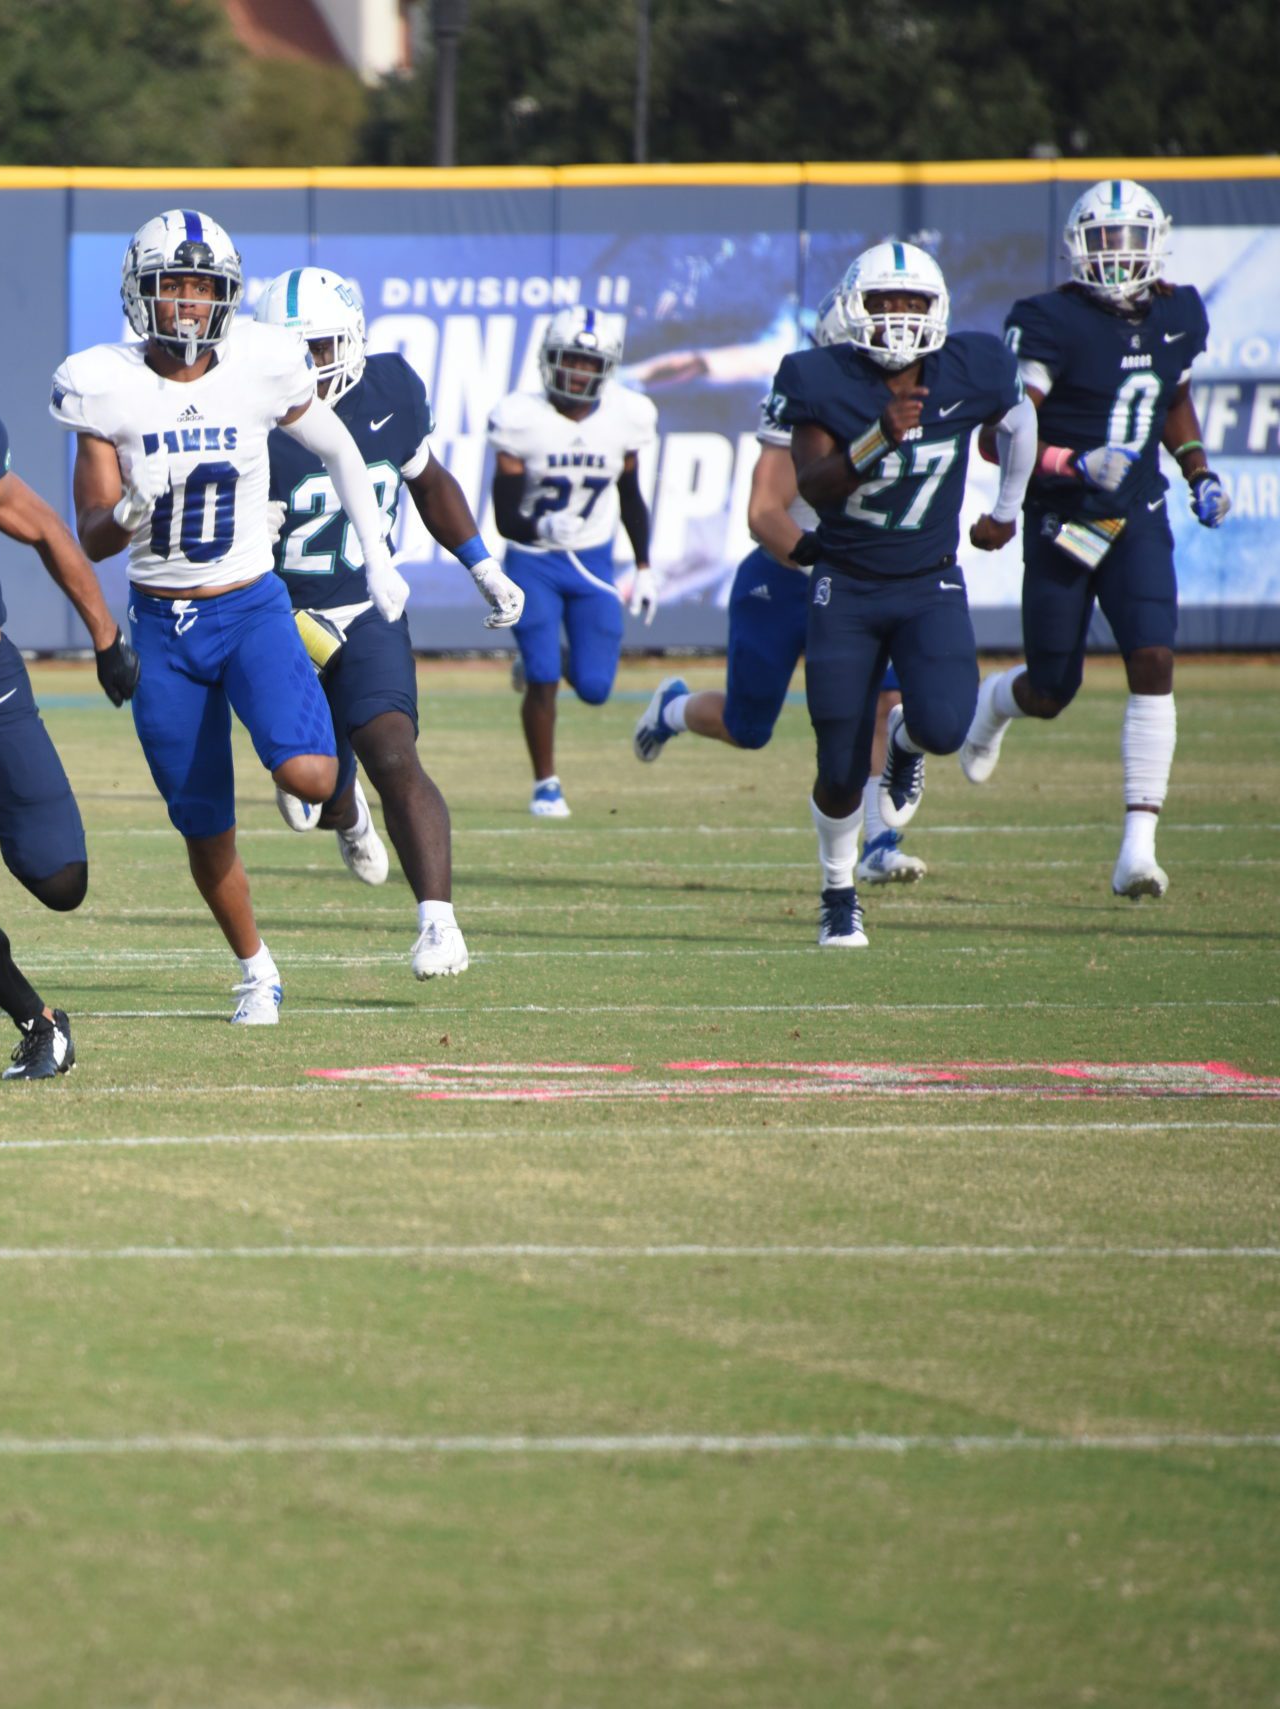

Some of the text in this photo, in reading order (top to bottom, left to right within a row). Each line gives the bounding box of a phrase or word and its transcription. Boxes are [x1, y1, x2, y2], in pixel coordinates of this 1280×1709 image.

[382, 276, 580, 307] DIVISION
[596, 276, 630, 305] II
[1120, 354, 1153, 370] ARGOS
[1107, 370, 1164, 453] 0
[547, 454, 606, 469] HAWKS
[532, 476, 612, 521] 27
[841, 433, 961, 530] 27
